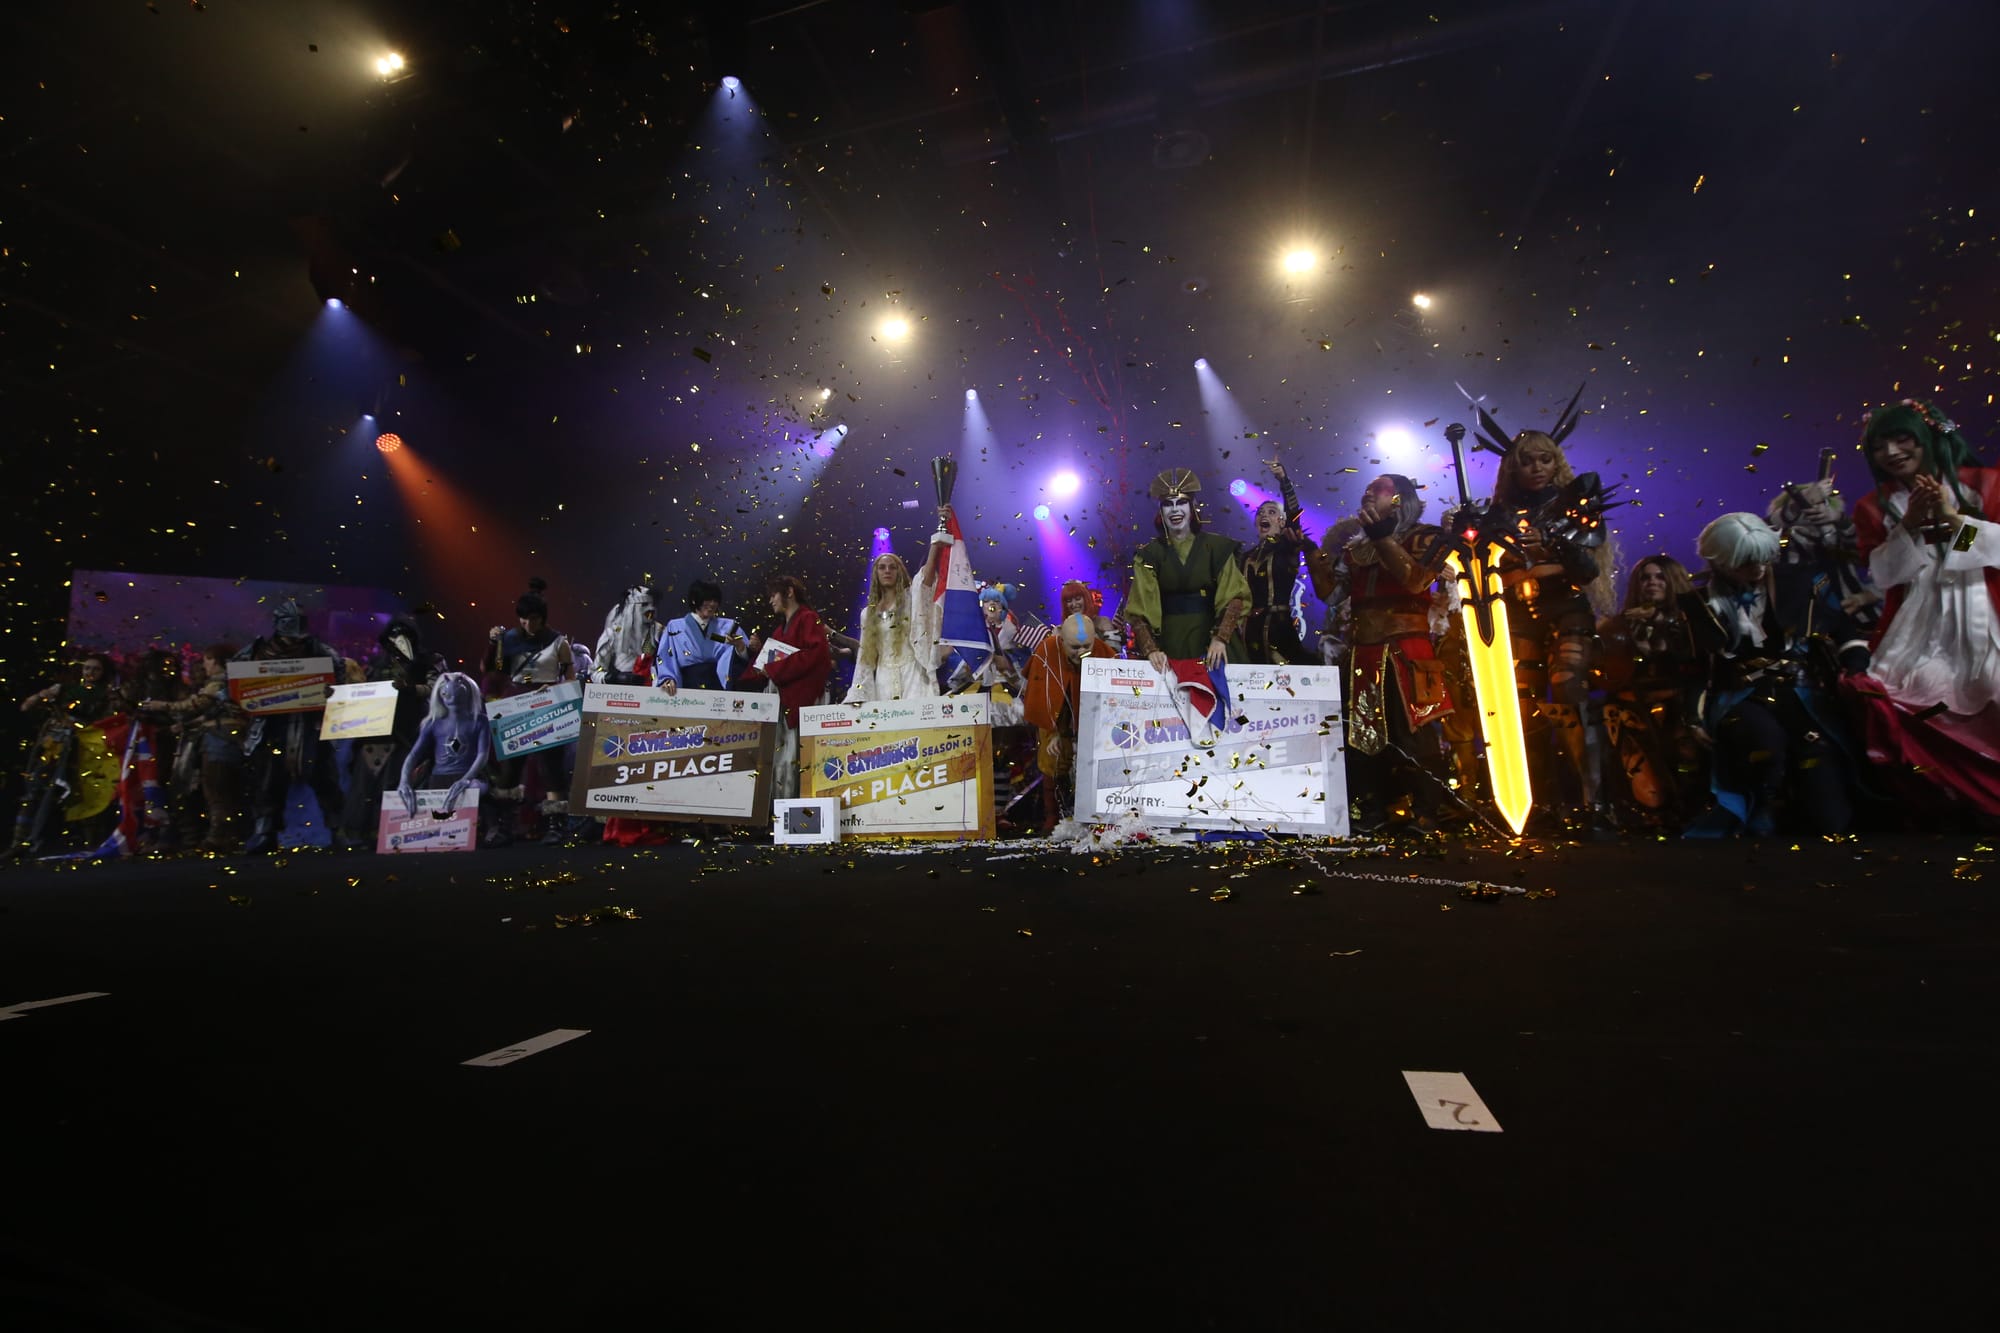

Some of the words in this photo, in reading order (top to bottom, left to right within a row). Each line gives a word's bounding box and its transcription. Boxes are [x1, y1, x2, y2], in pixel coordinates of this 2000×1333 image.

[1088, 664, 1145, 678] bernette
[588, 689, 635, 700] bernette
[504, 722, 528, 739] BEST
[529, 703, 574, 727] COSTUME
[803, 712, 846, 722] bernette
[1248, 715, 1299, 732] SEASON
[1303, 713, 1316, 725] 13
[748, 731, 759, 740] 13
[922, 739, 960, 758] SEASON
[962, 736, 973, 748] 13
[615, 763, 646, 784] 3rd
[653, 753, 733, 779] PLACE
[842, 785, 864, 806] 1st
[871, 763, 948, 800] PLACE
[594, 794, 638, 804] COUNTRY:
[1106, 795, 1165, 806] COUNTRY:
[400, 818, 429, 831] BEST
[1438, 1098, 1481, 1126] 2
